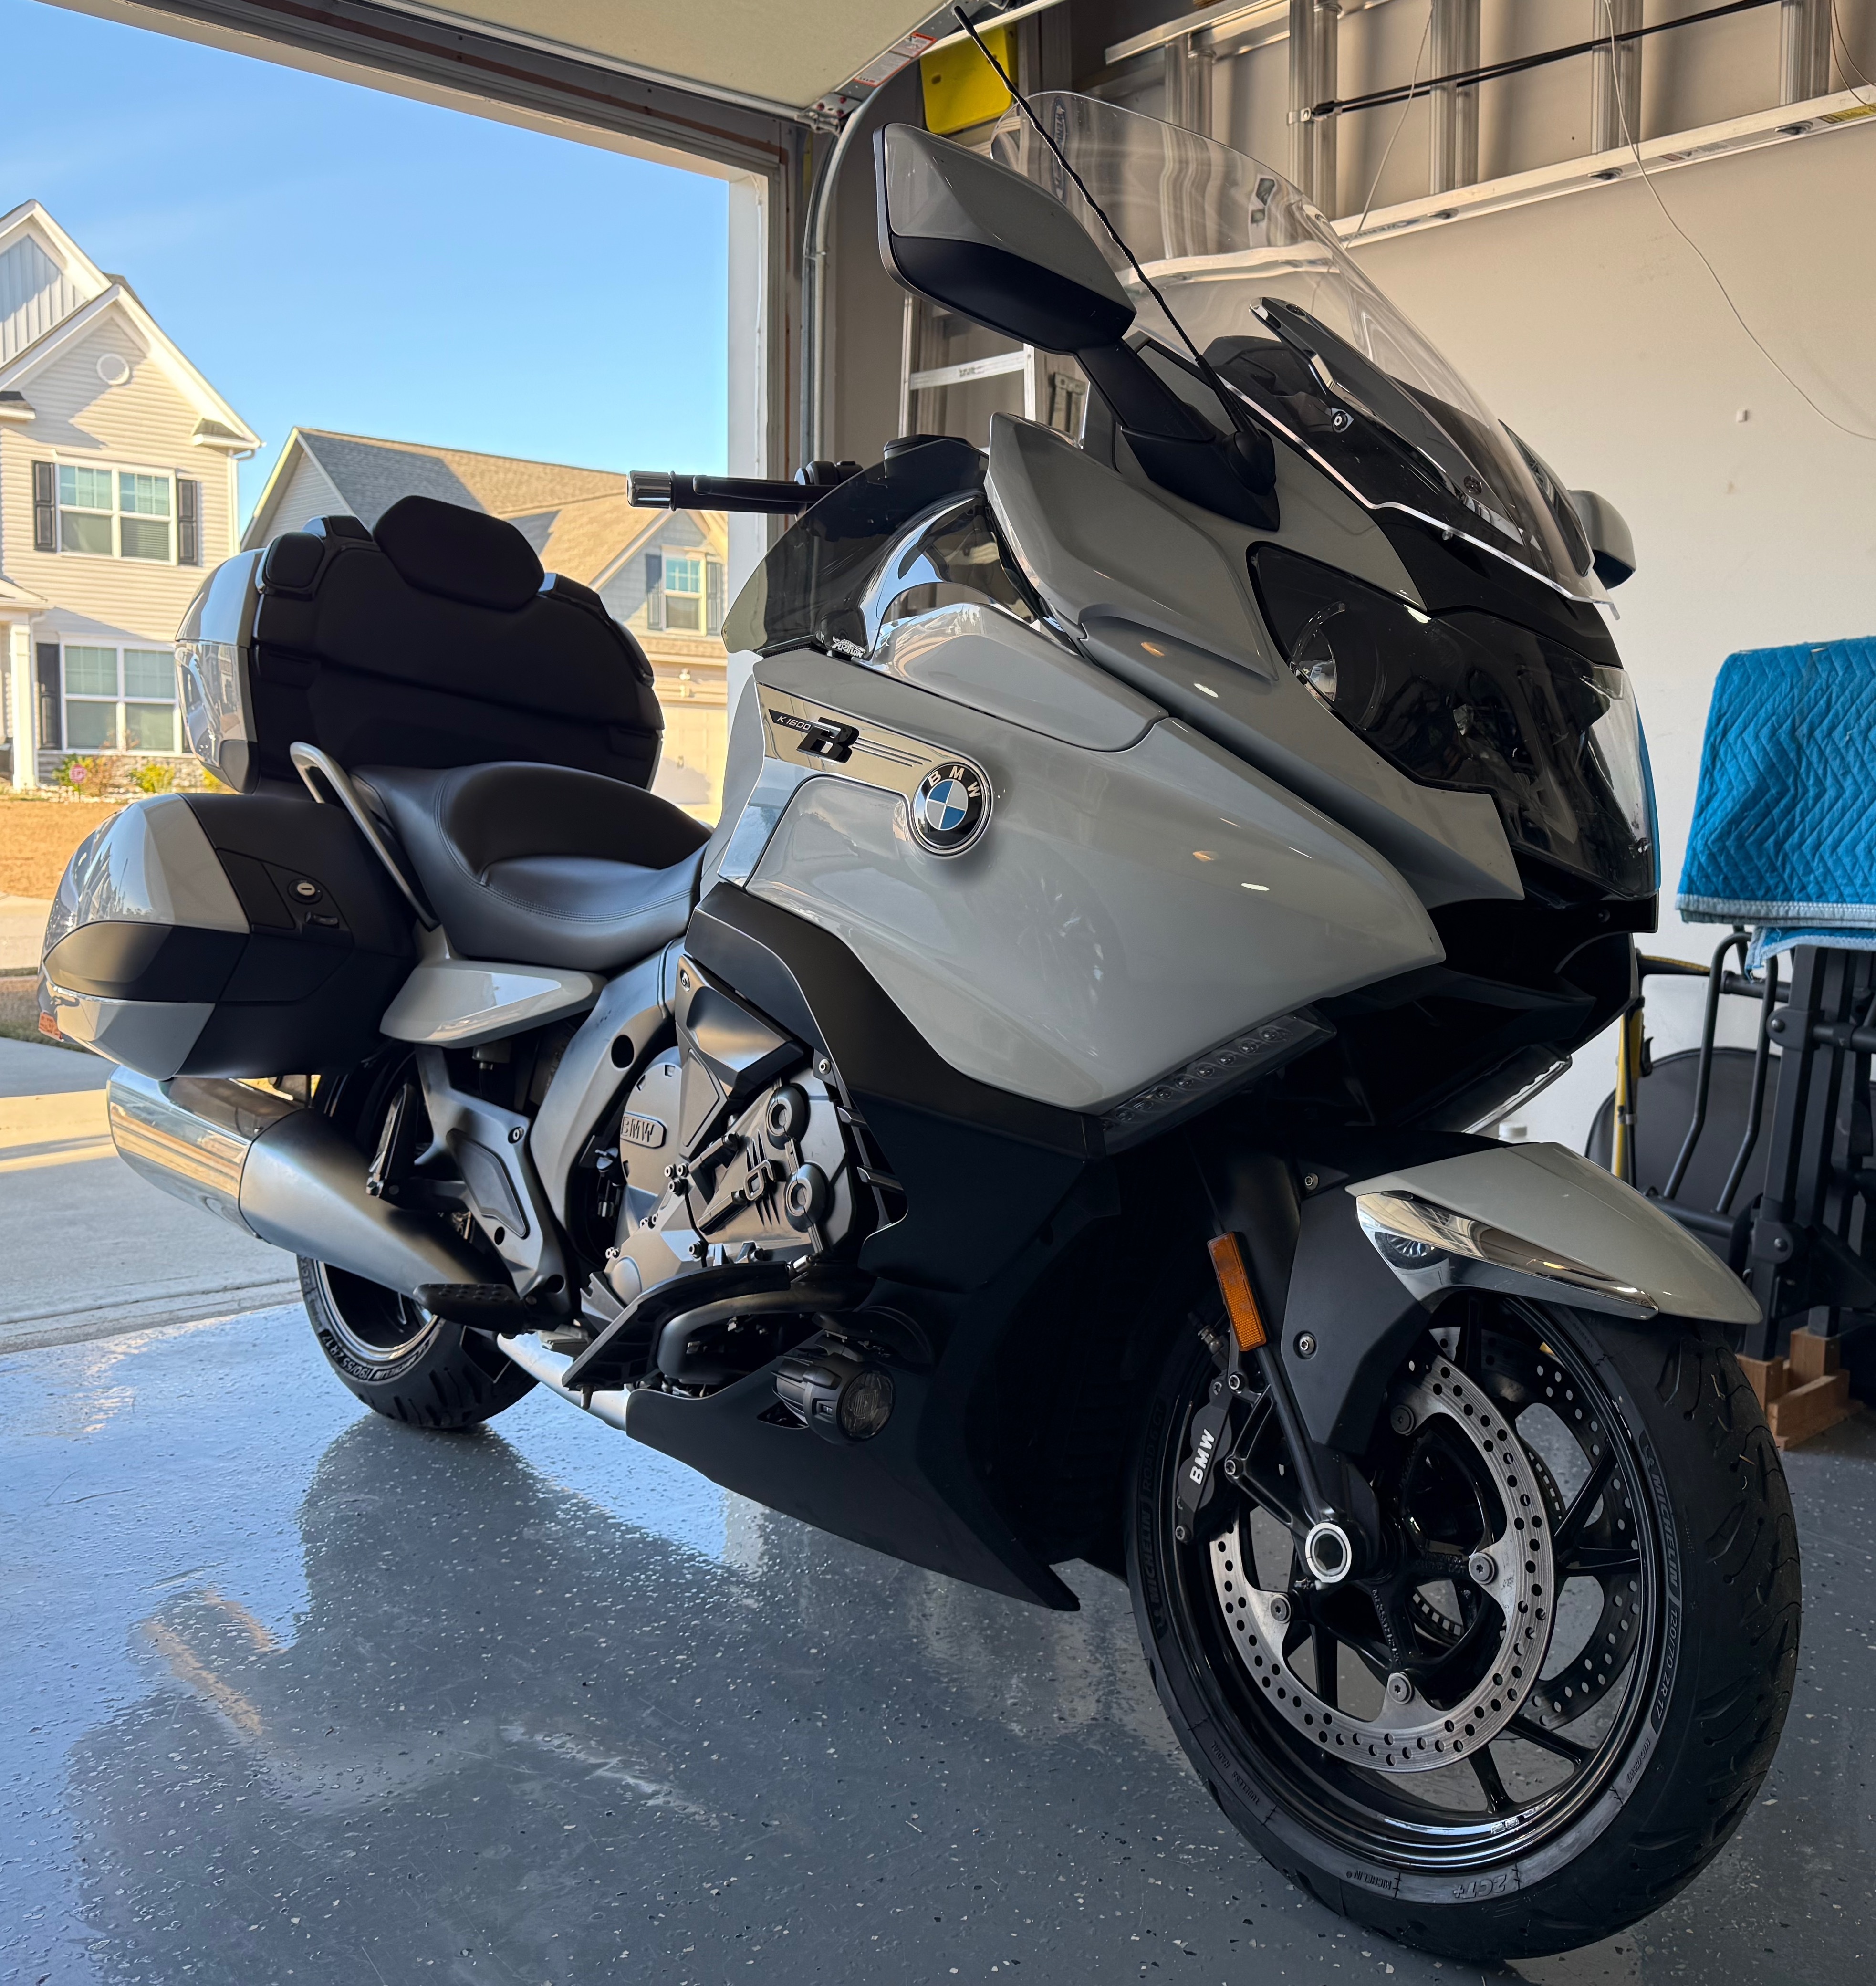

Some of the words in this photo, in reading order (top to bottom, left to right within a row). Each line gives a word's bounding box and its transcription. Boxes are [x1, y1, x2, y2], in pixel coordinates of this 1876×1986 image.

[786, 718, 812, 731] 1600
[928, 765, 981, 798] BMW
[621, 1116, 655, 1143] BMW
[342, 1358, 372, 1380] 190/55
[1142, 1444, 1156, 1493] ROAD
[1189, 1428, 1215, 1485] BMW
[1651, 1473, 1679, 1588] MICHELIN
[1140, 1508, 1160, 1604] MICHELIN
[1666, 1609, 1678, 1669] 120/70
[1660, 1671, 1671, 1698] ZR
[1656, 1700, 1665, 1720] 17
[1210, 1740, 1231, 1769] RADIAL
[1453, 1874, 1507, 1900] 2CT+
